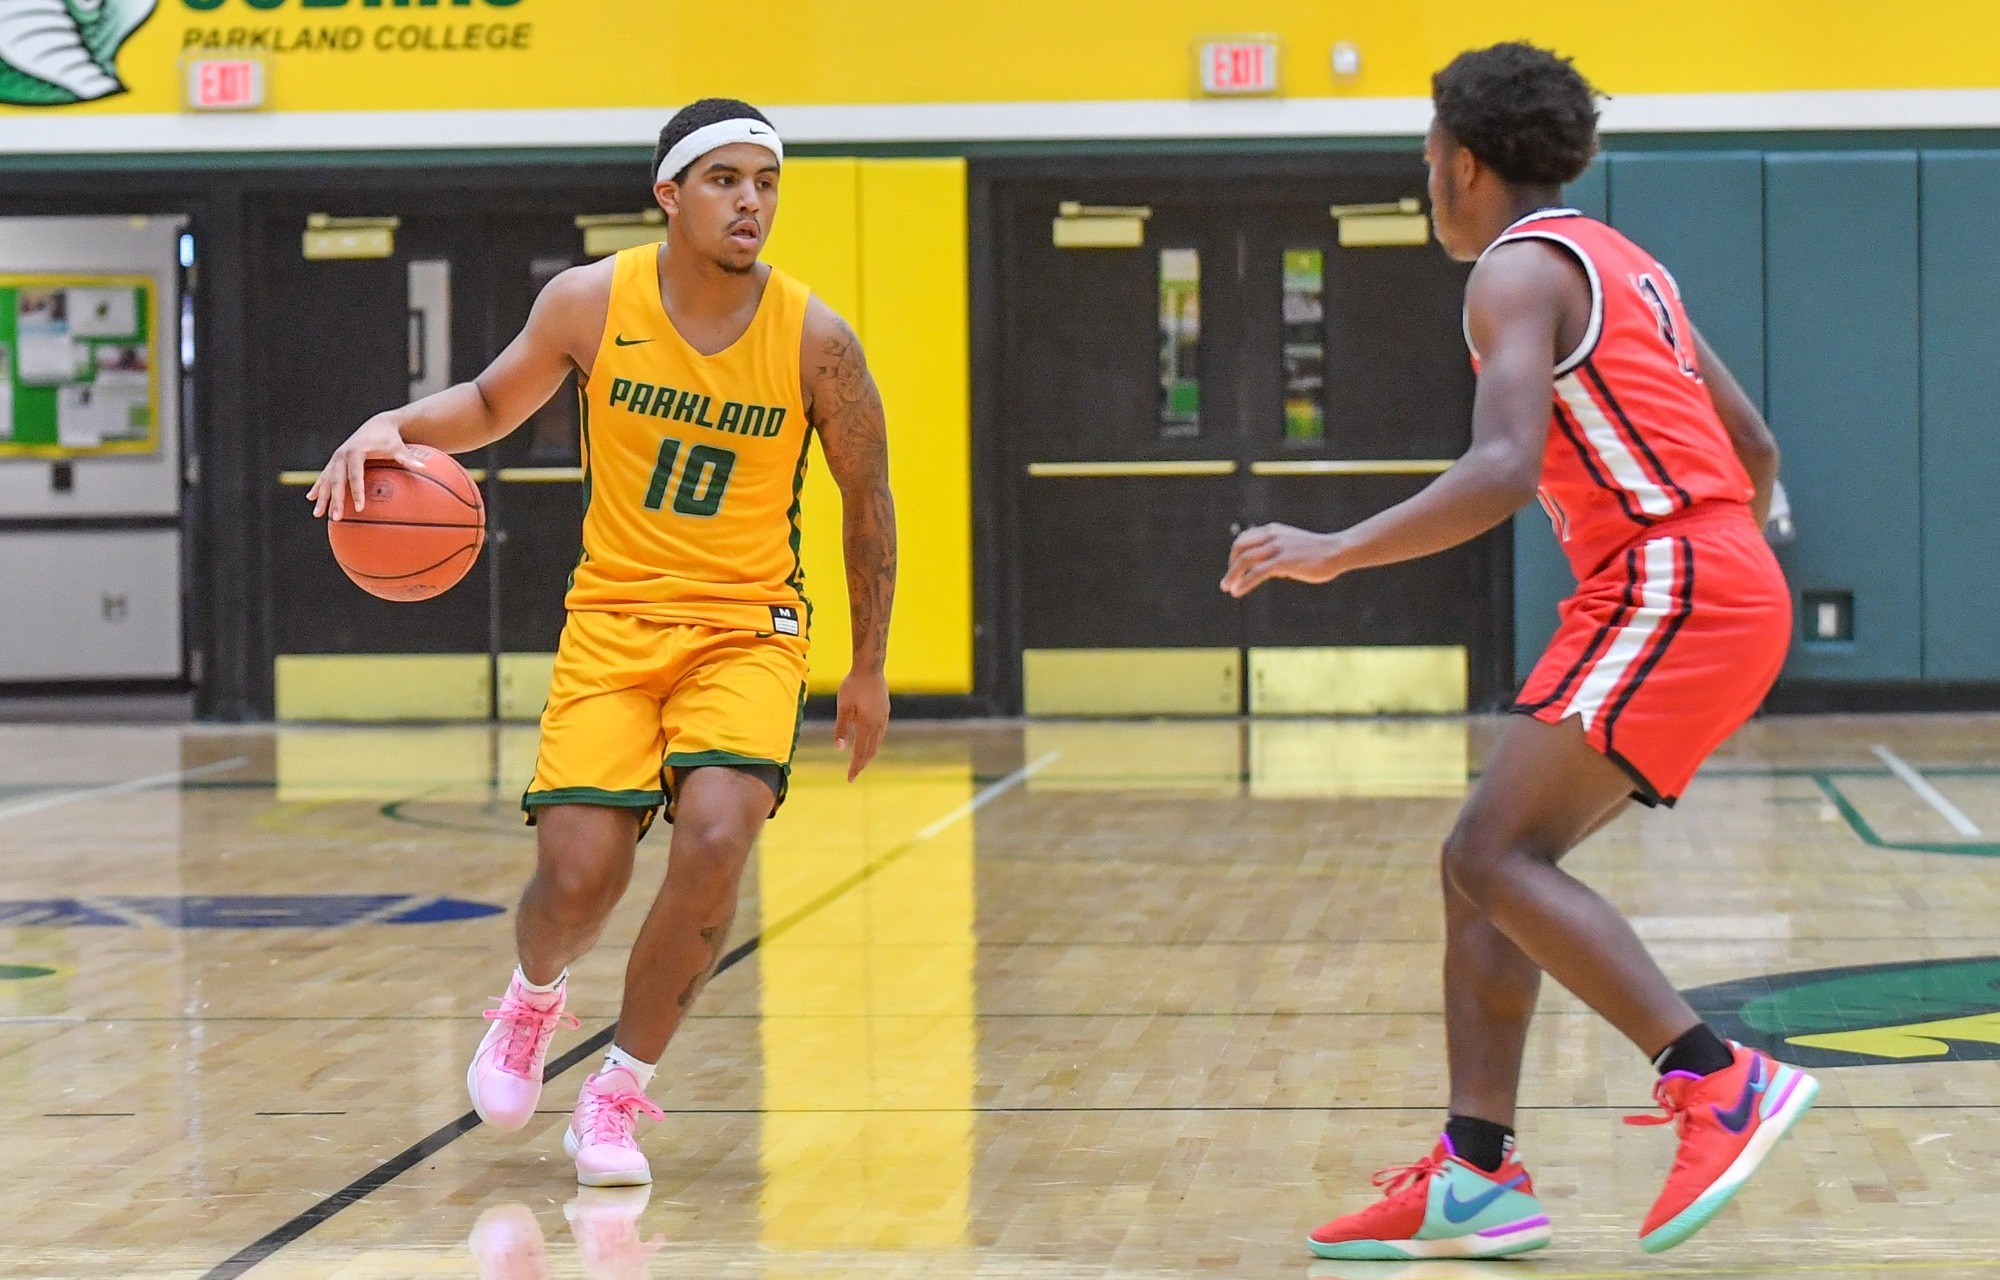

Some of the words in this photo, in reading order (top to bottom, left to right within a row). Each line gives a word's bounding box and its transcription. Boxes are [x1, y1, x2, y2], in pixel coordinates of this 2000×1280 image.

[182, 26, 364, 52] PARKLAND
[373, 22, 532, 51] COLLEGE
[200, 63, 252, 106] EXIT
[1212, 45, 1264, 88] EXIT
[608, 377, 787, 438] PARKLAND
[643, 436, 737, 518] 10
[778, 607, 792, 618] M
